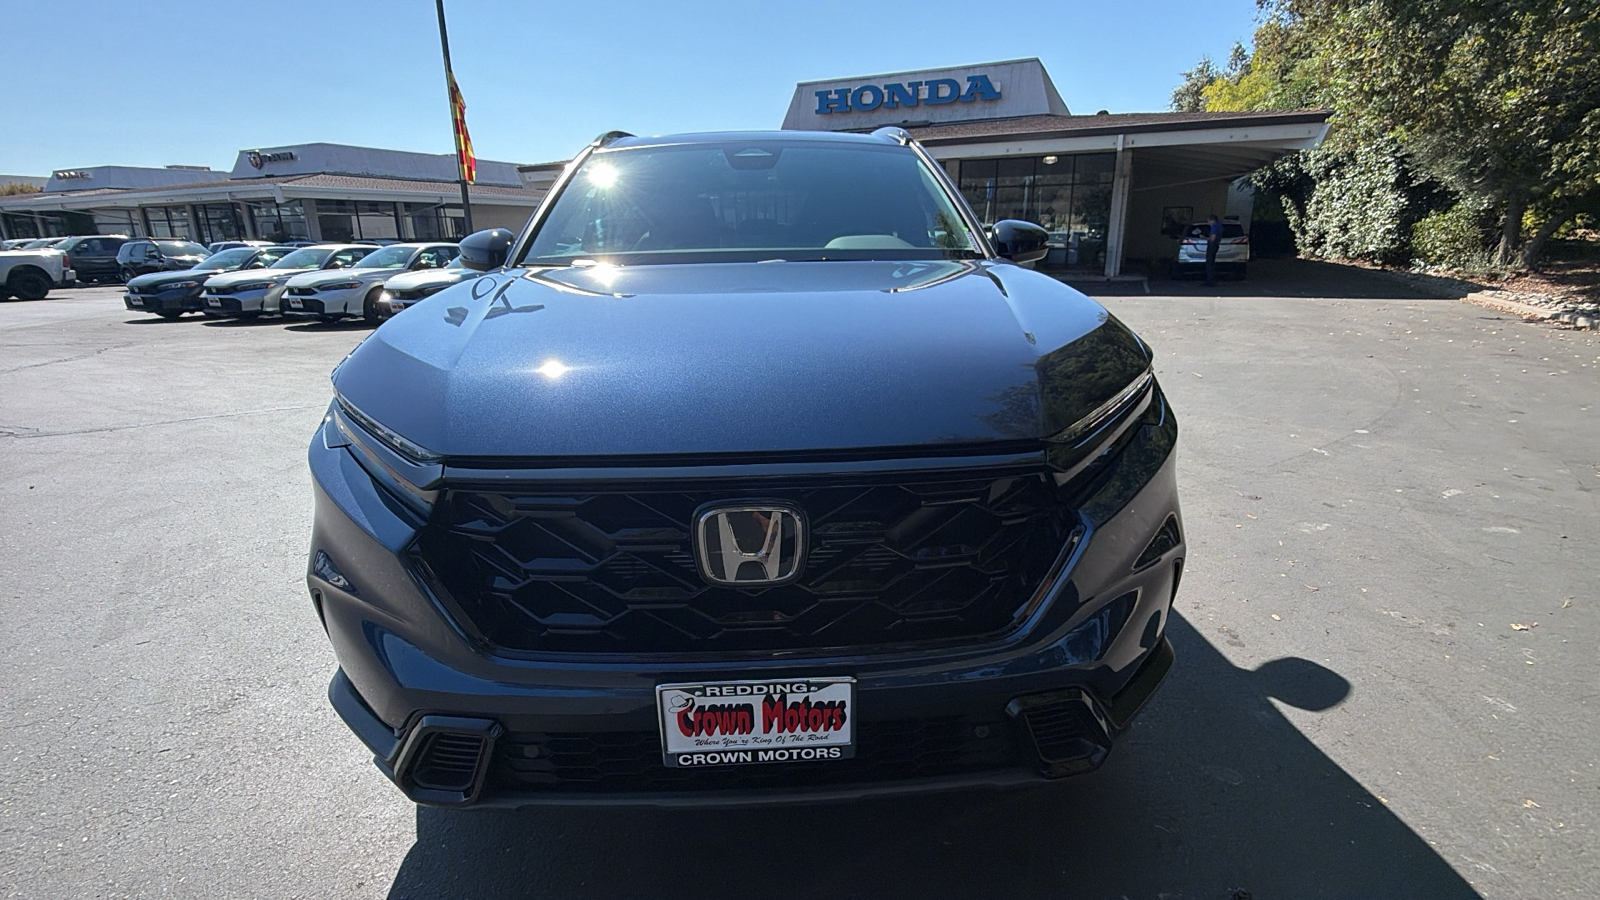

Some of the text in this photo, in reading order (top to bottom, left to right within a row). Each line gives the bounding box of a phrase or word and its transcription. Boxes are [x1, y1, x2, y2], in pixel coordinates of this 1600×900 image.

[815, 74, 1002, 115] HONDA
[706, 683, 808, 697] REDDING
[677, 695, 846, 738] Crown Motors
[694, 733, 830, 747] Where You're King Of The Road
[678, 747, 842, 766] CROWN MOTORS
